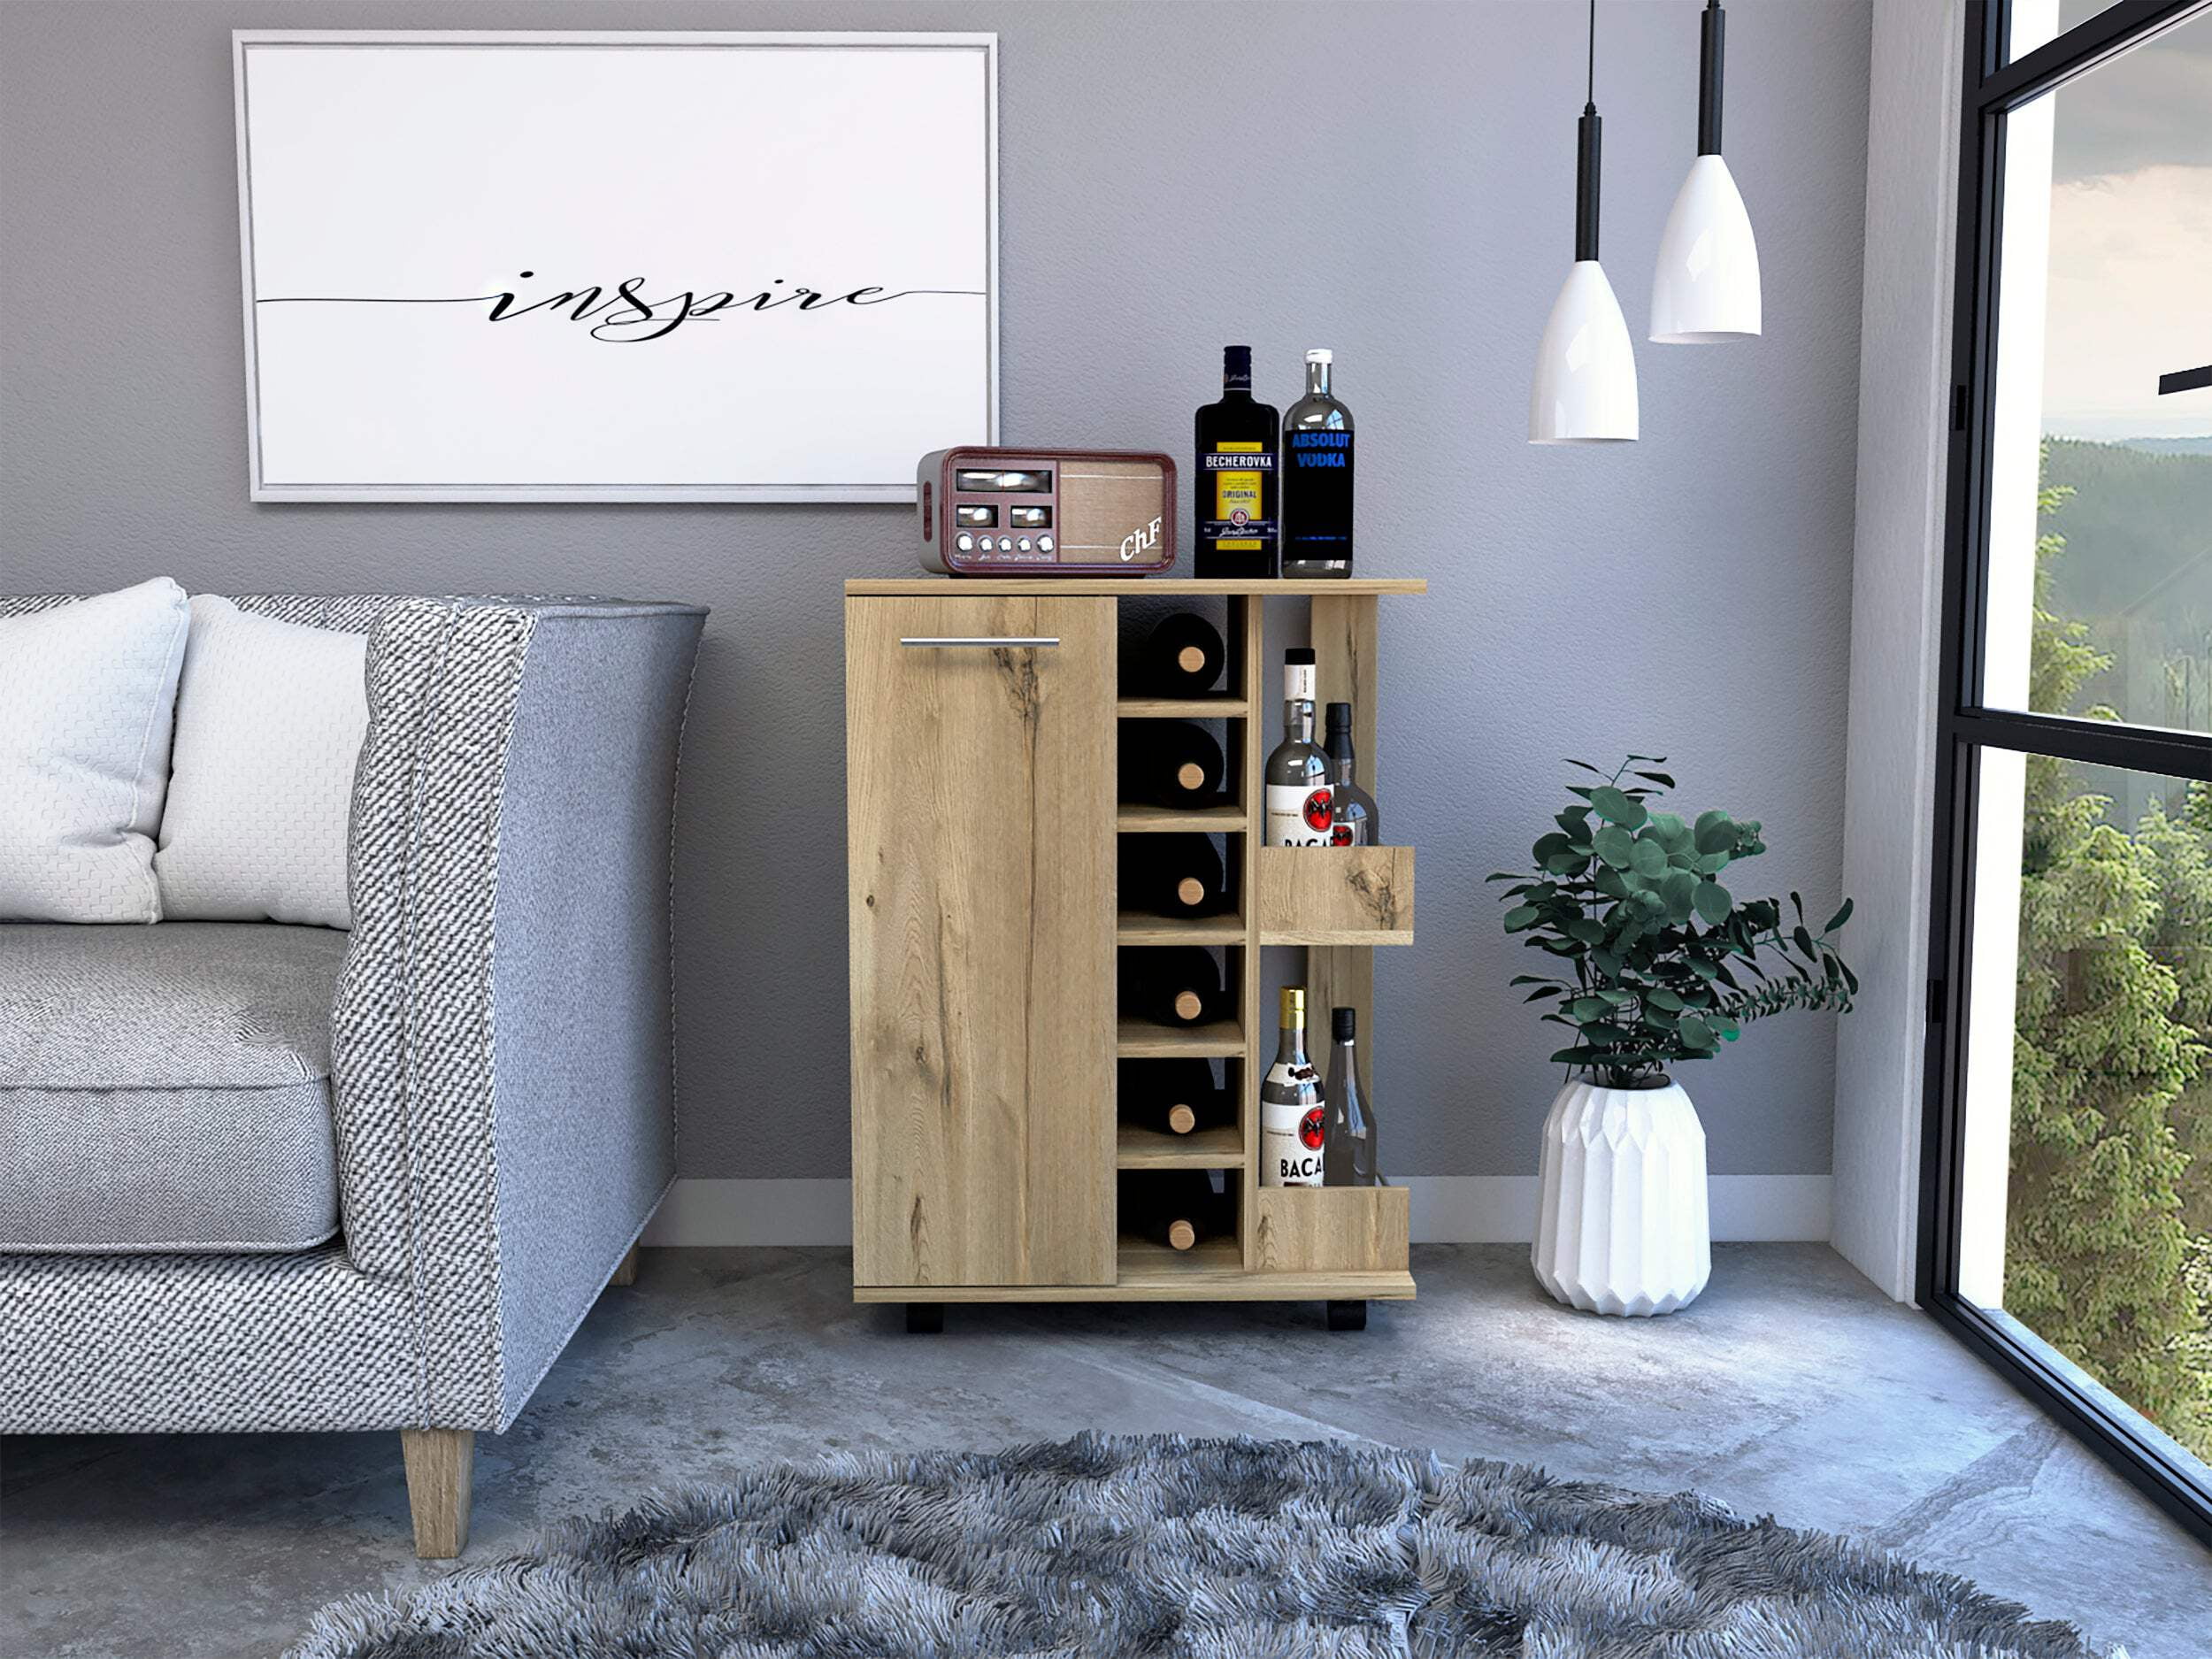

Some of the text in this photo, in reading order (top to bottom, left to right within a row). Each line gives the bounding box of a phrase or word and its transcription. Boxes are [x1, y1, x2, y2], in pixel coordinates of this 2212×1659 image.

[488, 270, 899, 342] inspire
[1292, 433, 1351, 448] ABSOLUT
[1205, 456, 1272, 468] BECHEROVKA
[1296, 452, 1346, 467] VODKA
[1222, 489, 1257, 499] ORIGINAL
[1118, 516, 1163, 562] ChF
[1280, 1156, 1325, 1178] BACA
